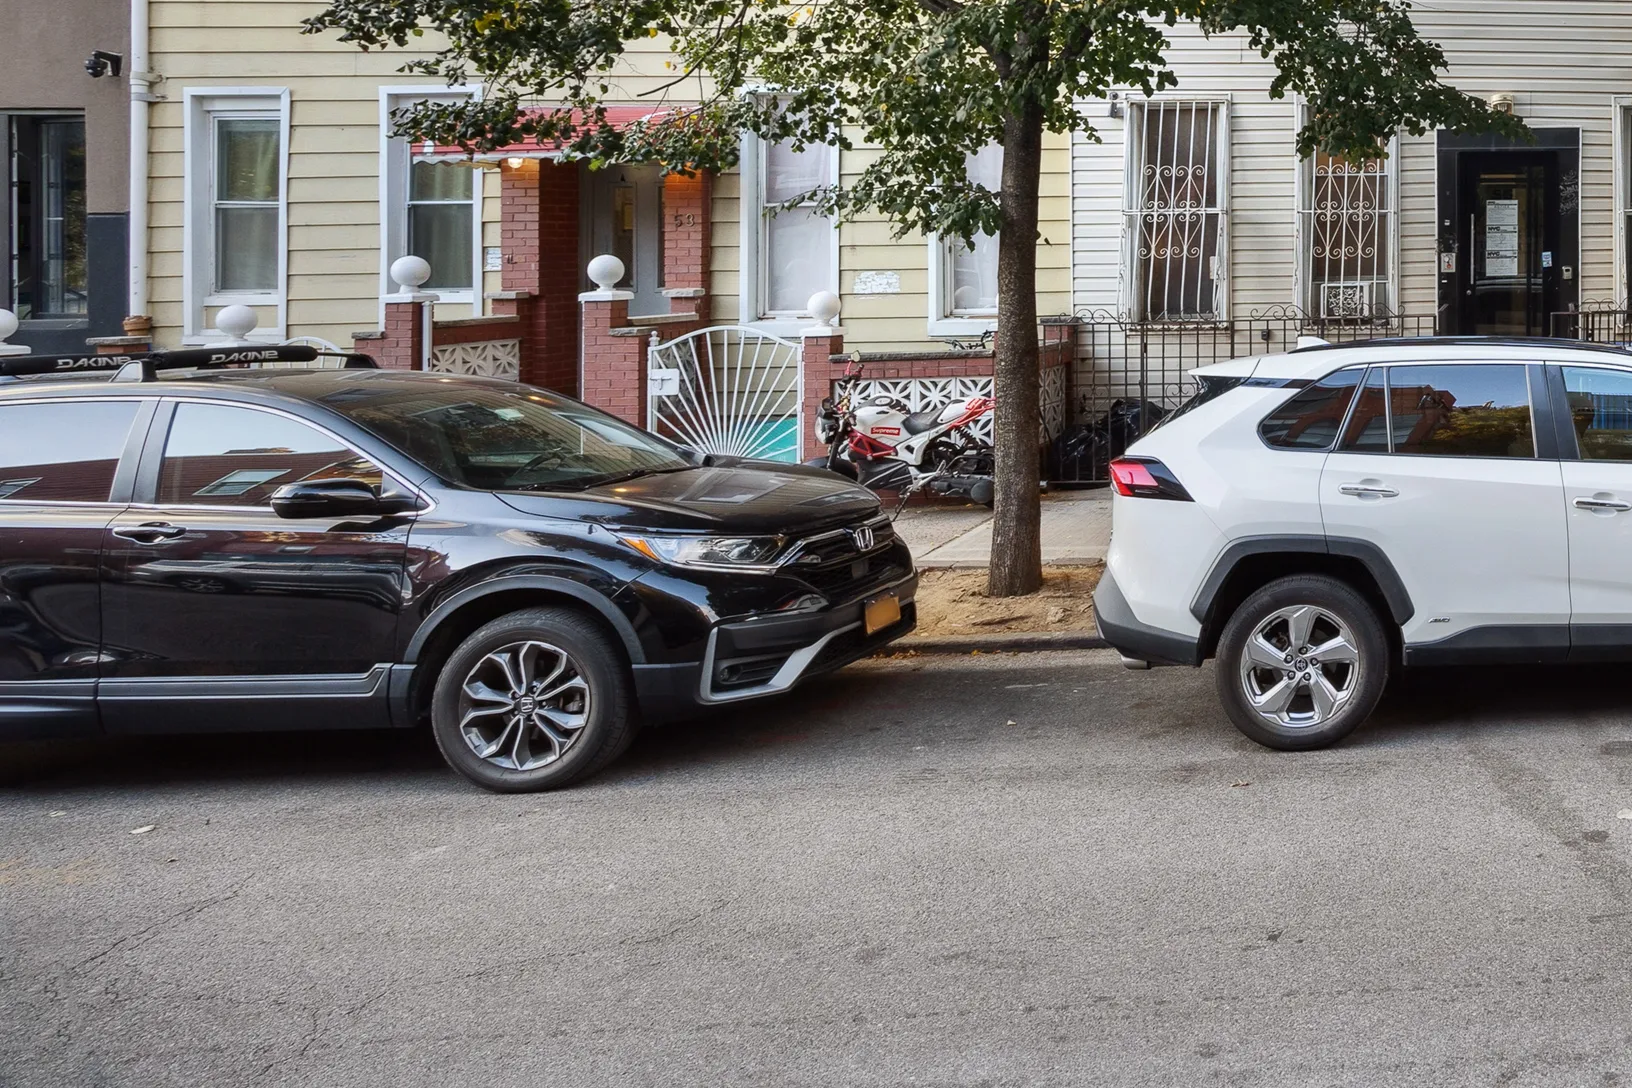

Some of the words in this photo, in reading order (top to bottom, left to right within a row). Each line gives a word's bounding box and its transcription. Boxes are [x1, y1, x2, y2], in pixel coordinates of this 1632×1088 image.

[673, 213, 694, 227] 53
[55, 356, 132, 369] DAKINE
[209, 350, 279, 364] DAKINE
